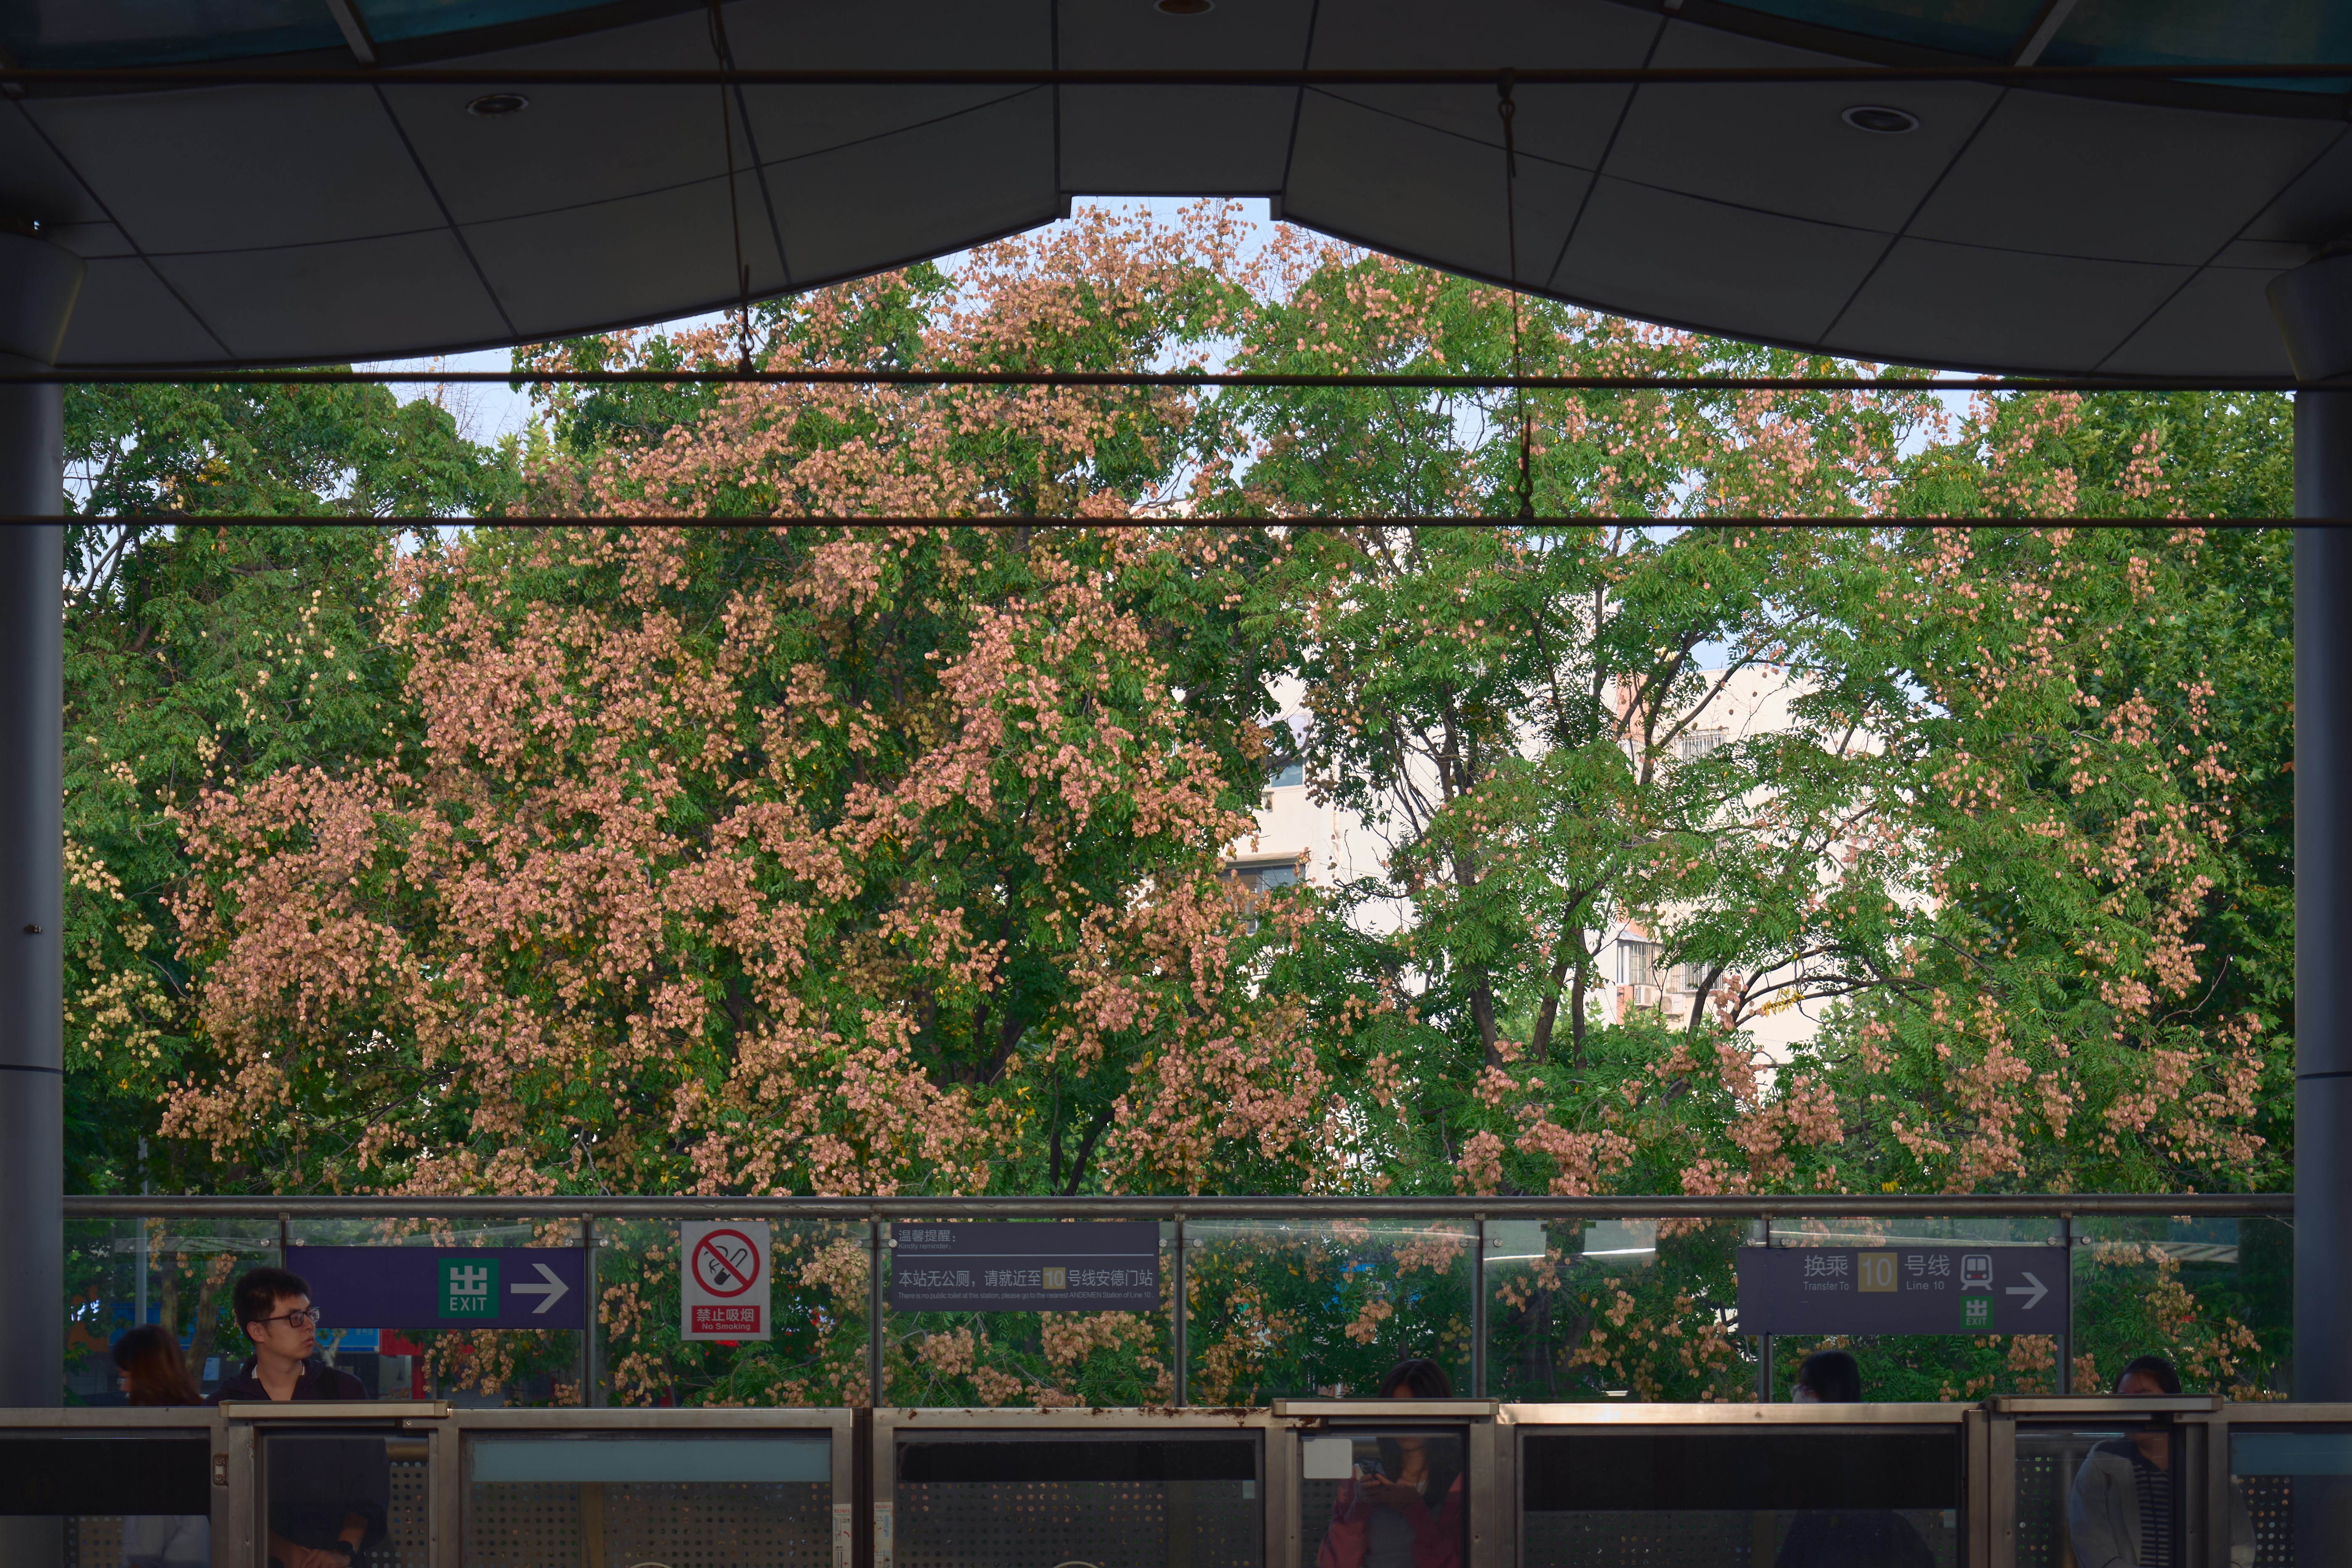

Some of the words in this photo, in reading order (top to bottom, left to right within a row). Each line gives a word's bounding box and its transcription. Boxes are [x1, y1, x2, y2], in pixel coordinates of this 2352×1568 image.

[1804, 1255, 1849, 1277] 换乘
[1862, 1257, 1892, 1287] 10
[1904, 1254, 1950, 1277] 号线
[1803, 1281, 1837, 1290] Transfer
[1839, 1281, 1849, 1290] To
[1906, 1281, 1929, 1290] Line
[1933, 1281, 1945, 1290] 10
[450, 1297, 487, 1311] EXIT
[696, 1308, 754, 1322] 禁止吸烟
[1966, 1317, 1987, 1325] EXIT
